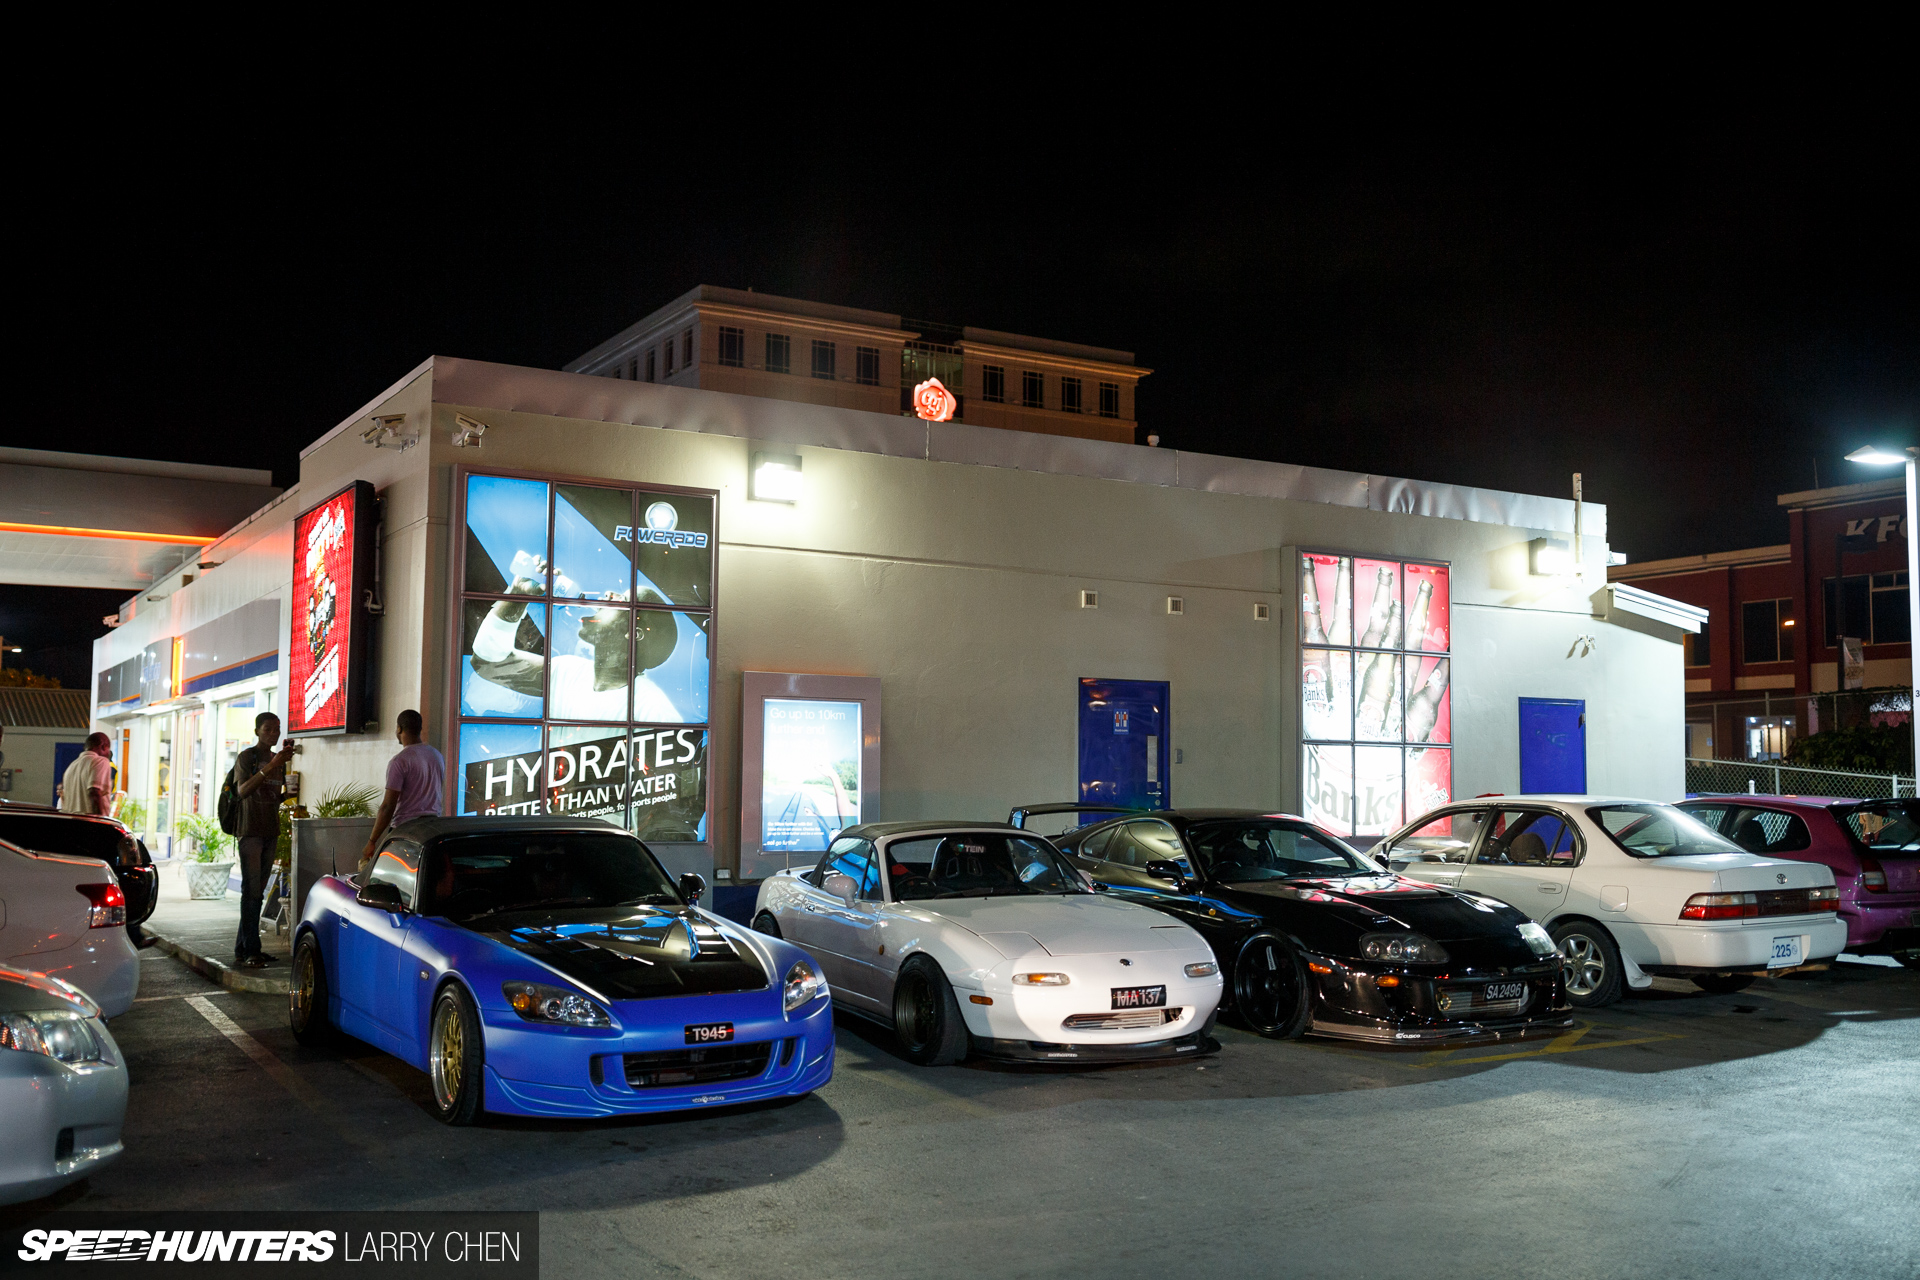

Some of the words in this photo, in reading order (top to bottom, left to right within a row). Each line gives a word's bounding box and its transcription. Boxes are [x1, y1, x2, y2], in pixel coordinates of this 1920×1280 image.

[770, 707, 786, 719] Go
[789, 711, 802, 721] up
[804, 709, 815, 720] to
[818, 709, 846, 721] 10km
[806, 724, 825, 735] and
[484, 729, 696, 800] HYDRATES
[557, 786, 610, 812] THAN
[615, 773, 676, 801] WATER
[1307, 752, 1400, 826] Banks
[588, 805, 616, 818] people,
[617, 803, 625, 811] fo
[630, 798, 651, 809] ports
[652, 792, 677, 805] people
[964, 845, 985, 854] TEIN
[692, 1026, 727, 1042] T945
